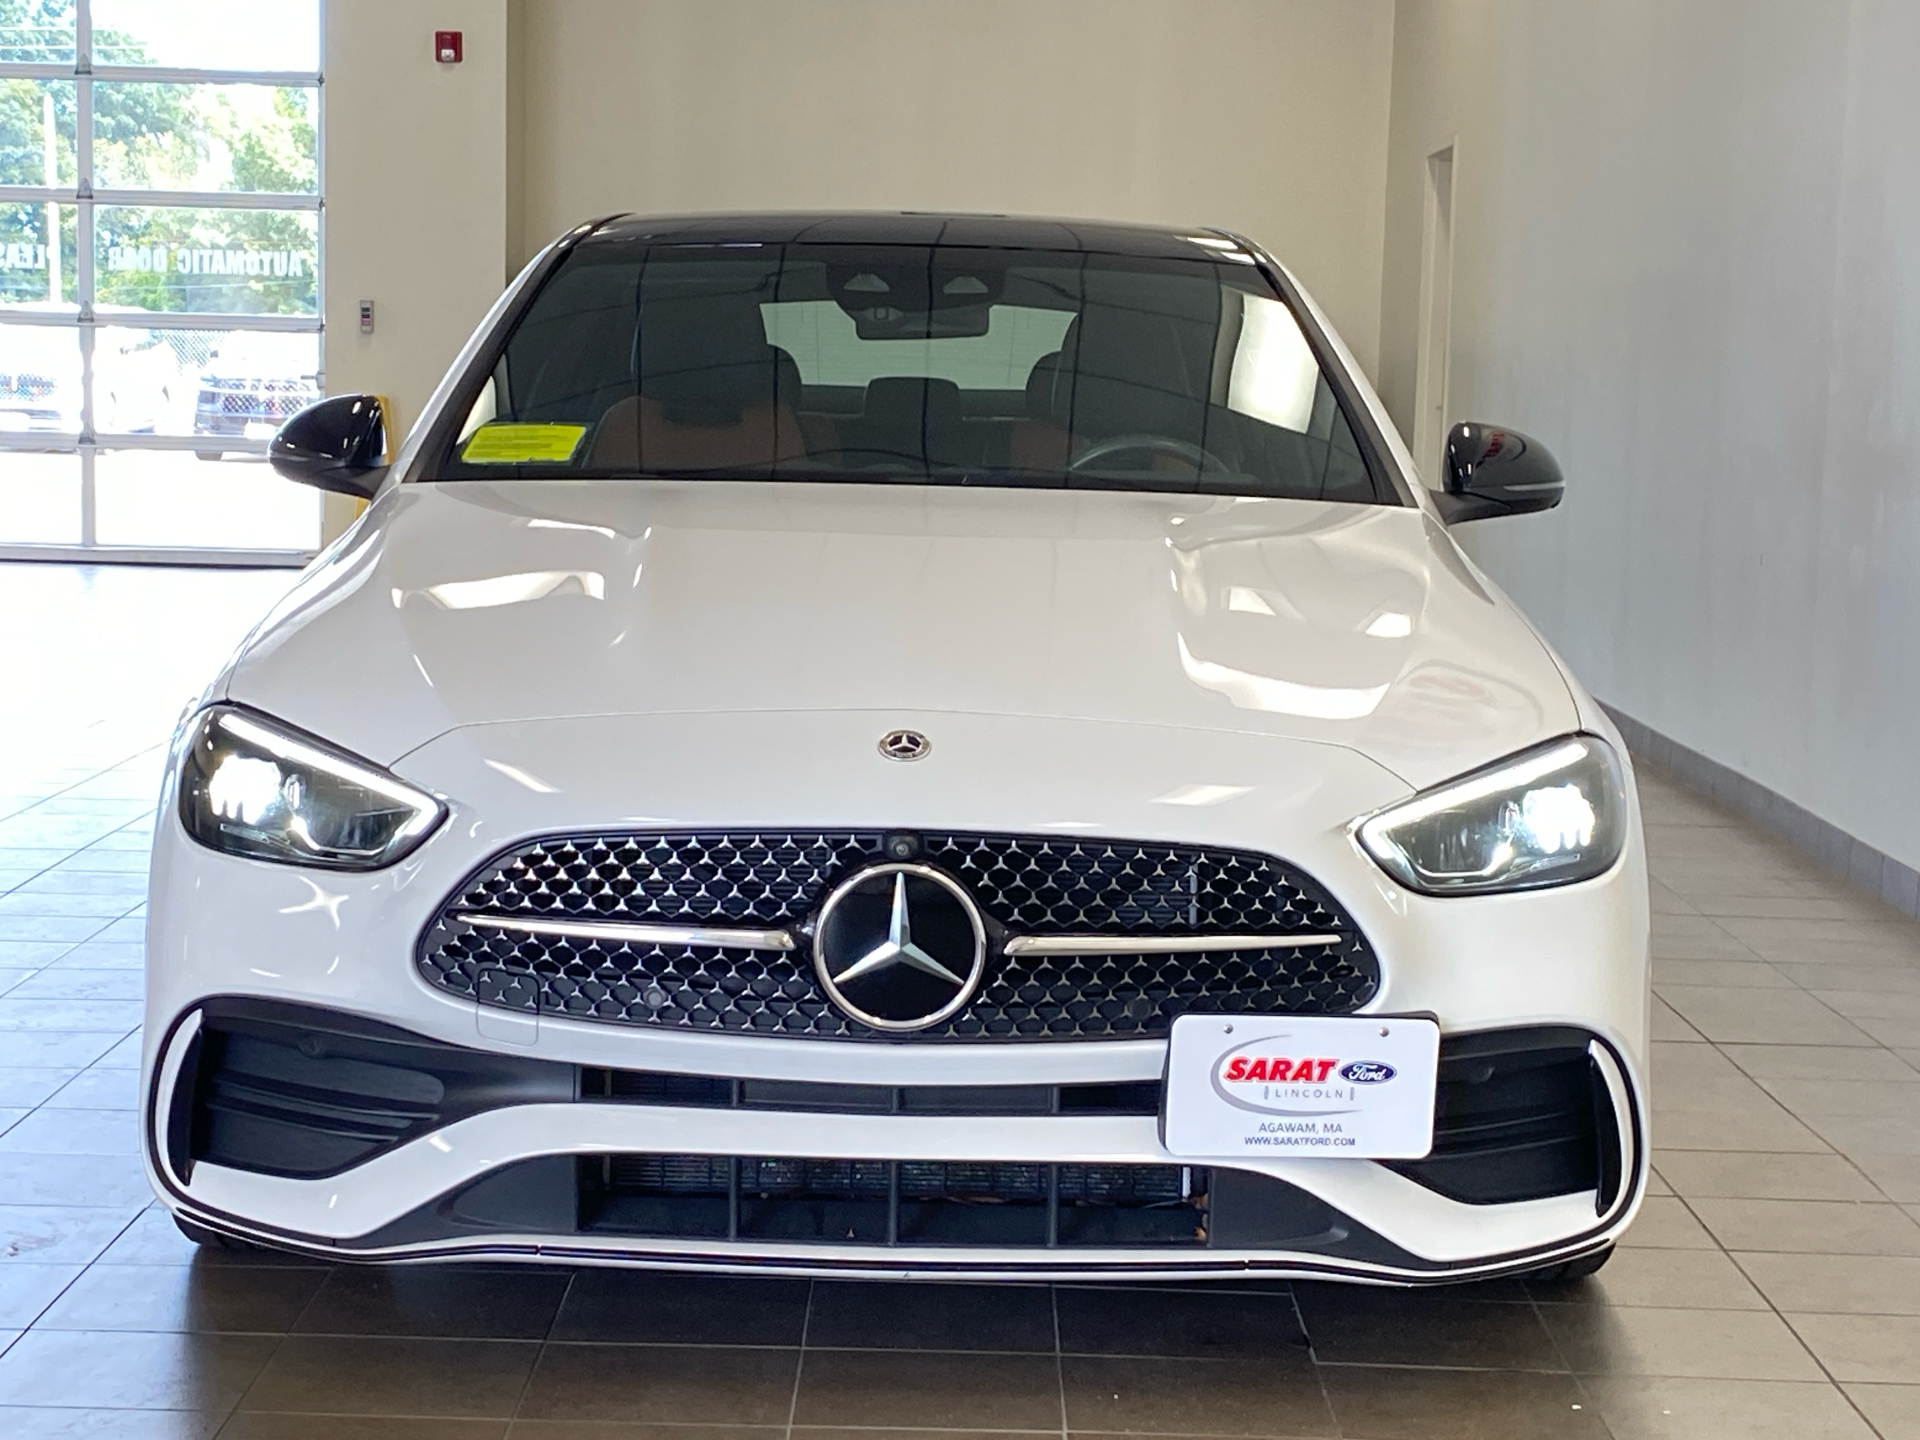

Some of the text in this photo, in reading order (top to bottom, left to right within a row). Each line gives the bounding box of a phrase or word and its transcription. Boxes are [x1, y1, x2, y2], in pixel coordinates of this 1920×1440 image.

[1225, 1057, 1388, 1083] SARAT Ford
[1275, 1088, 1343, 1099] LINCOLN
[1258, 1122, 1343, 1134] AGAWAM, MA
[1244, 1136, 1356, 1147] WWW.SARATFORD.COM
